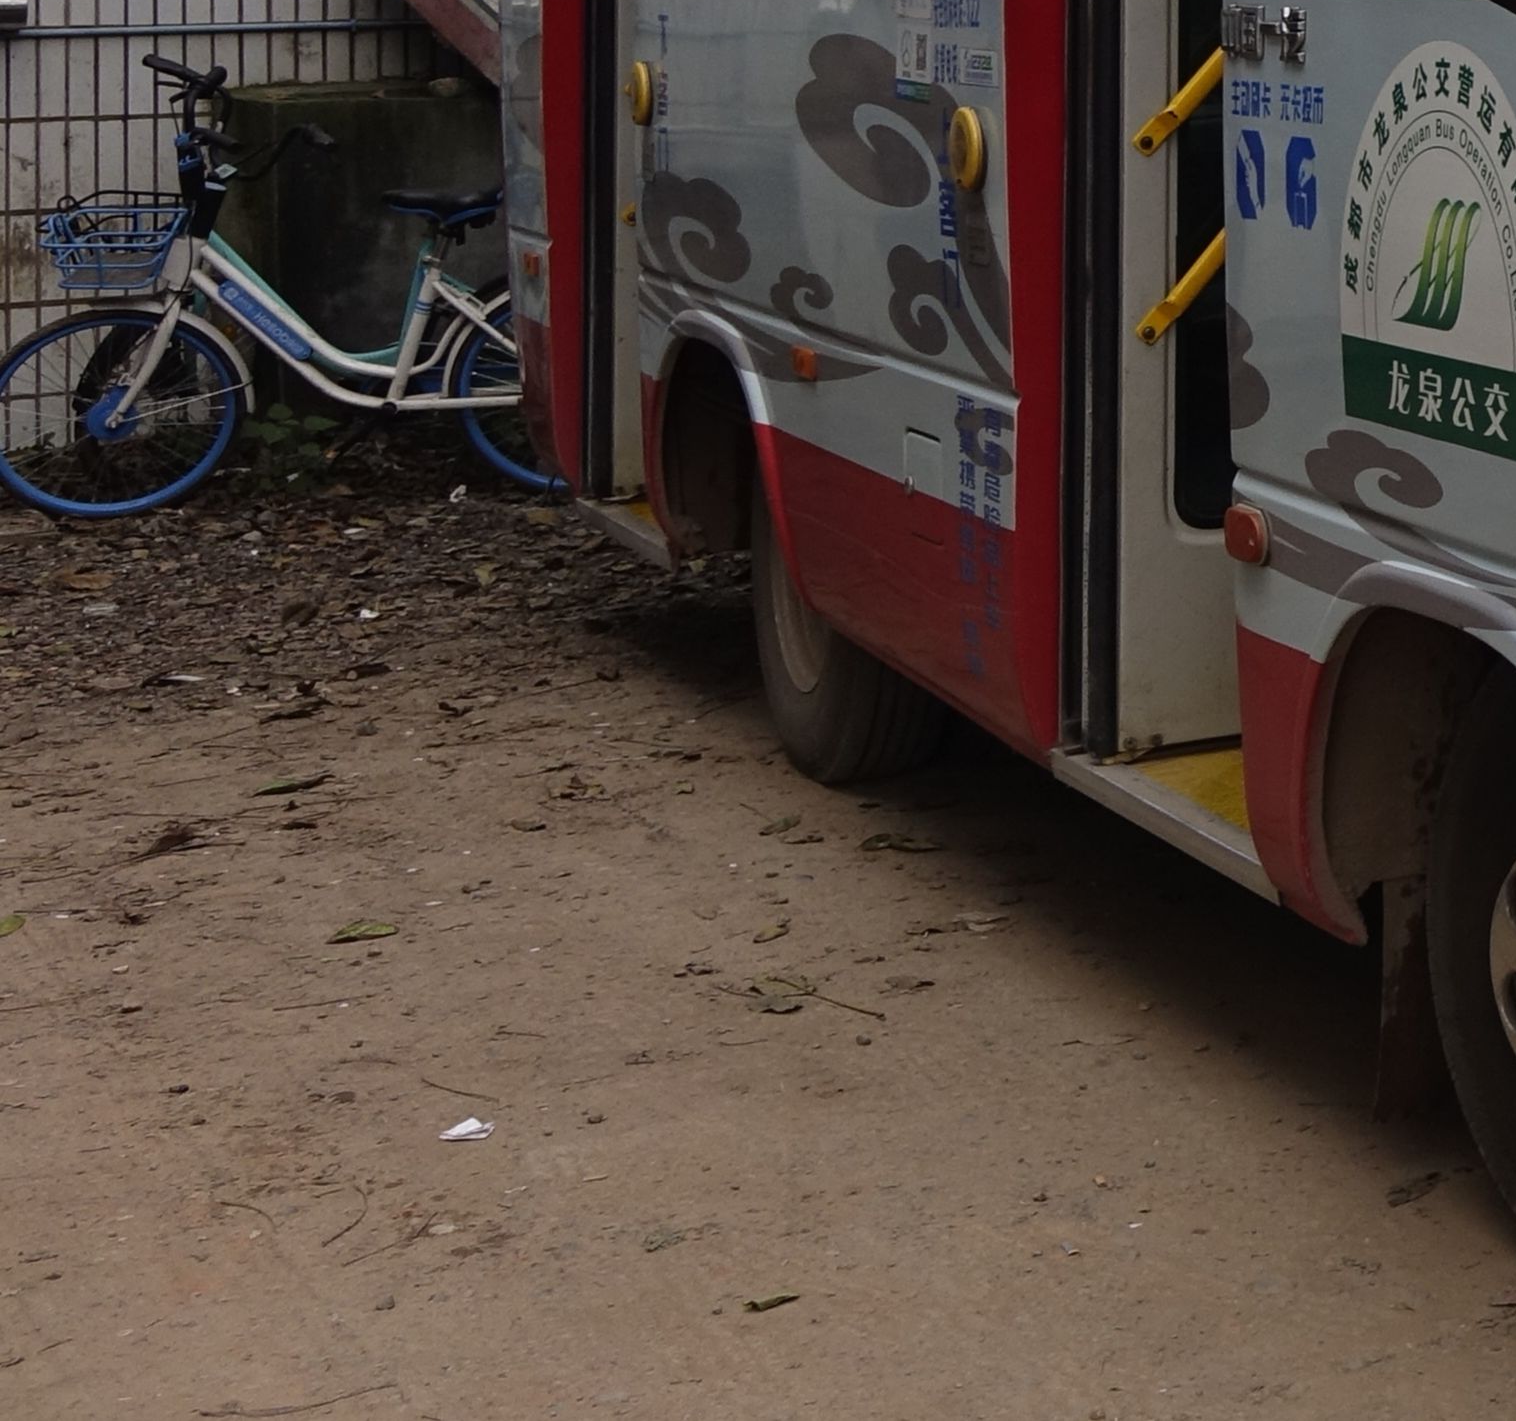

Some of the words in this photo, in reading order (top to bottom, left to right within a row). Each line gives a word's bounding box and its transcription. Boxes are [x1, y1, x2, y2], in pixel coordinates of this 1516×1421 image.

[1365, 192, 1388, 293] Chengdu
[1385, 127, 1432, 186] Longquan
[1435, 118, 1456, 142] Bus
[1458, 127, 1504, 217] Operation
[1388, 359, 1510, 443] 龙泉公交
